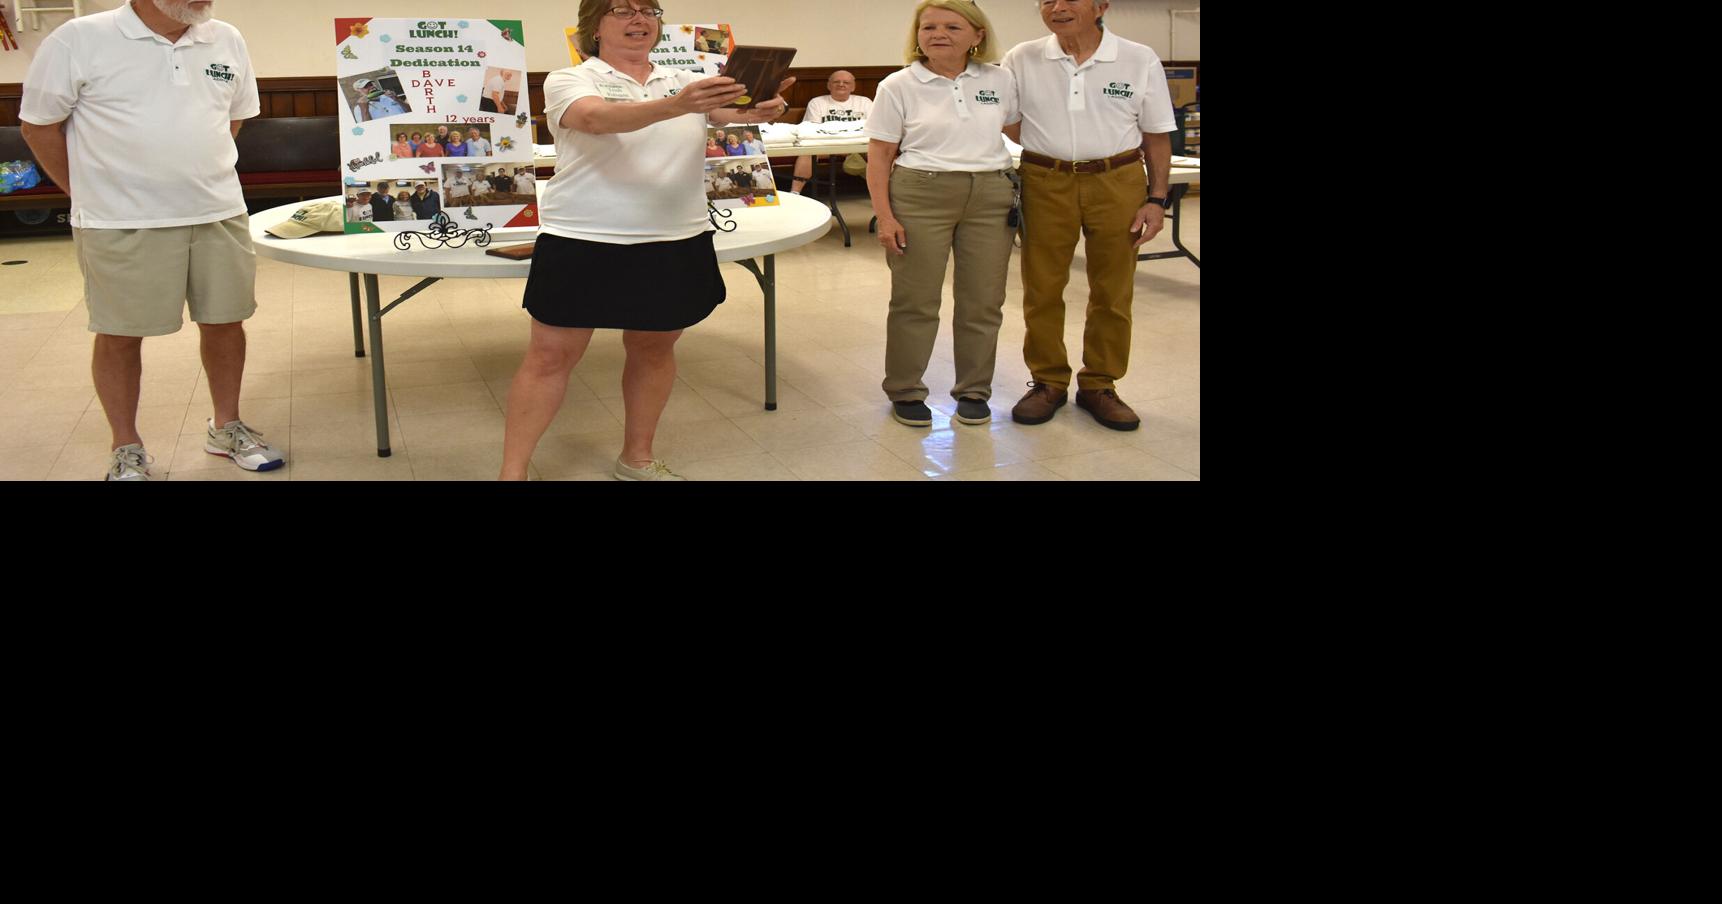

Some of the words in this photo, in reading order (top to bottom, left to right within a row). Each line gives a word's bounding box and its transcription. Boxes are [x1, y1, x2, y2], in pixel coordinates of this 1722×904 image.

[417, 21, 447, 29] GOT
[409, 30, 459, 38] LUNCH!
[395, 45, 455, 53] Season
[458, 45, 473, 53] 14
[390, 59, 481, 67] Dedication
[652, 58, 696, 66] ation
[411, 79, 456, 88] DAVE
[462, 116, 495, 125] years
